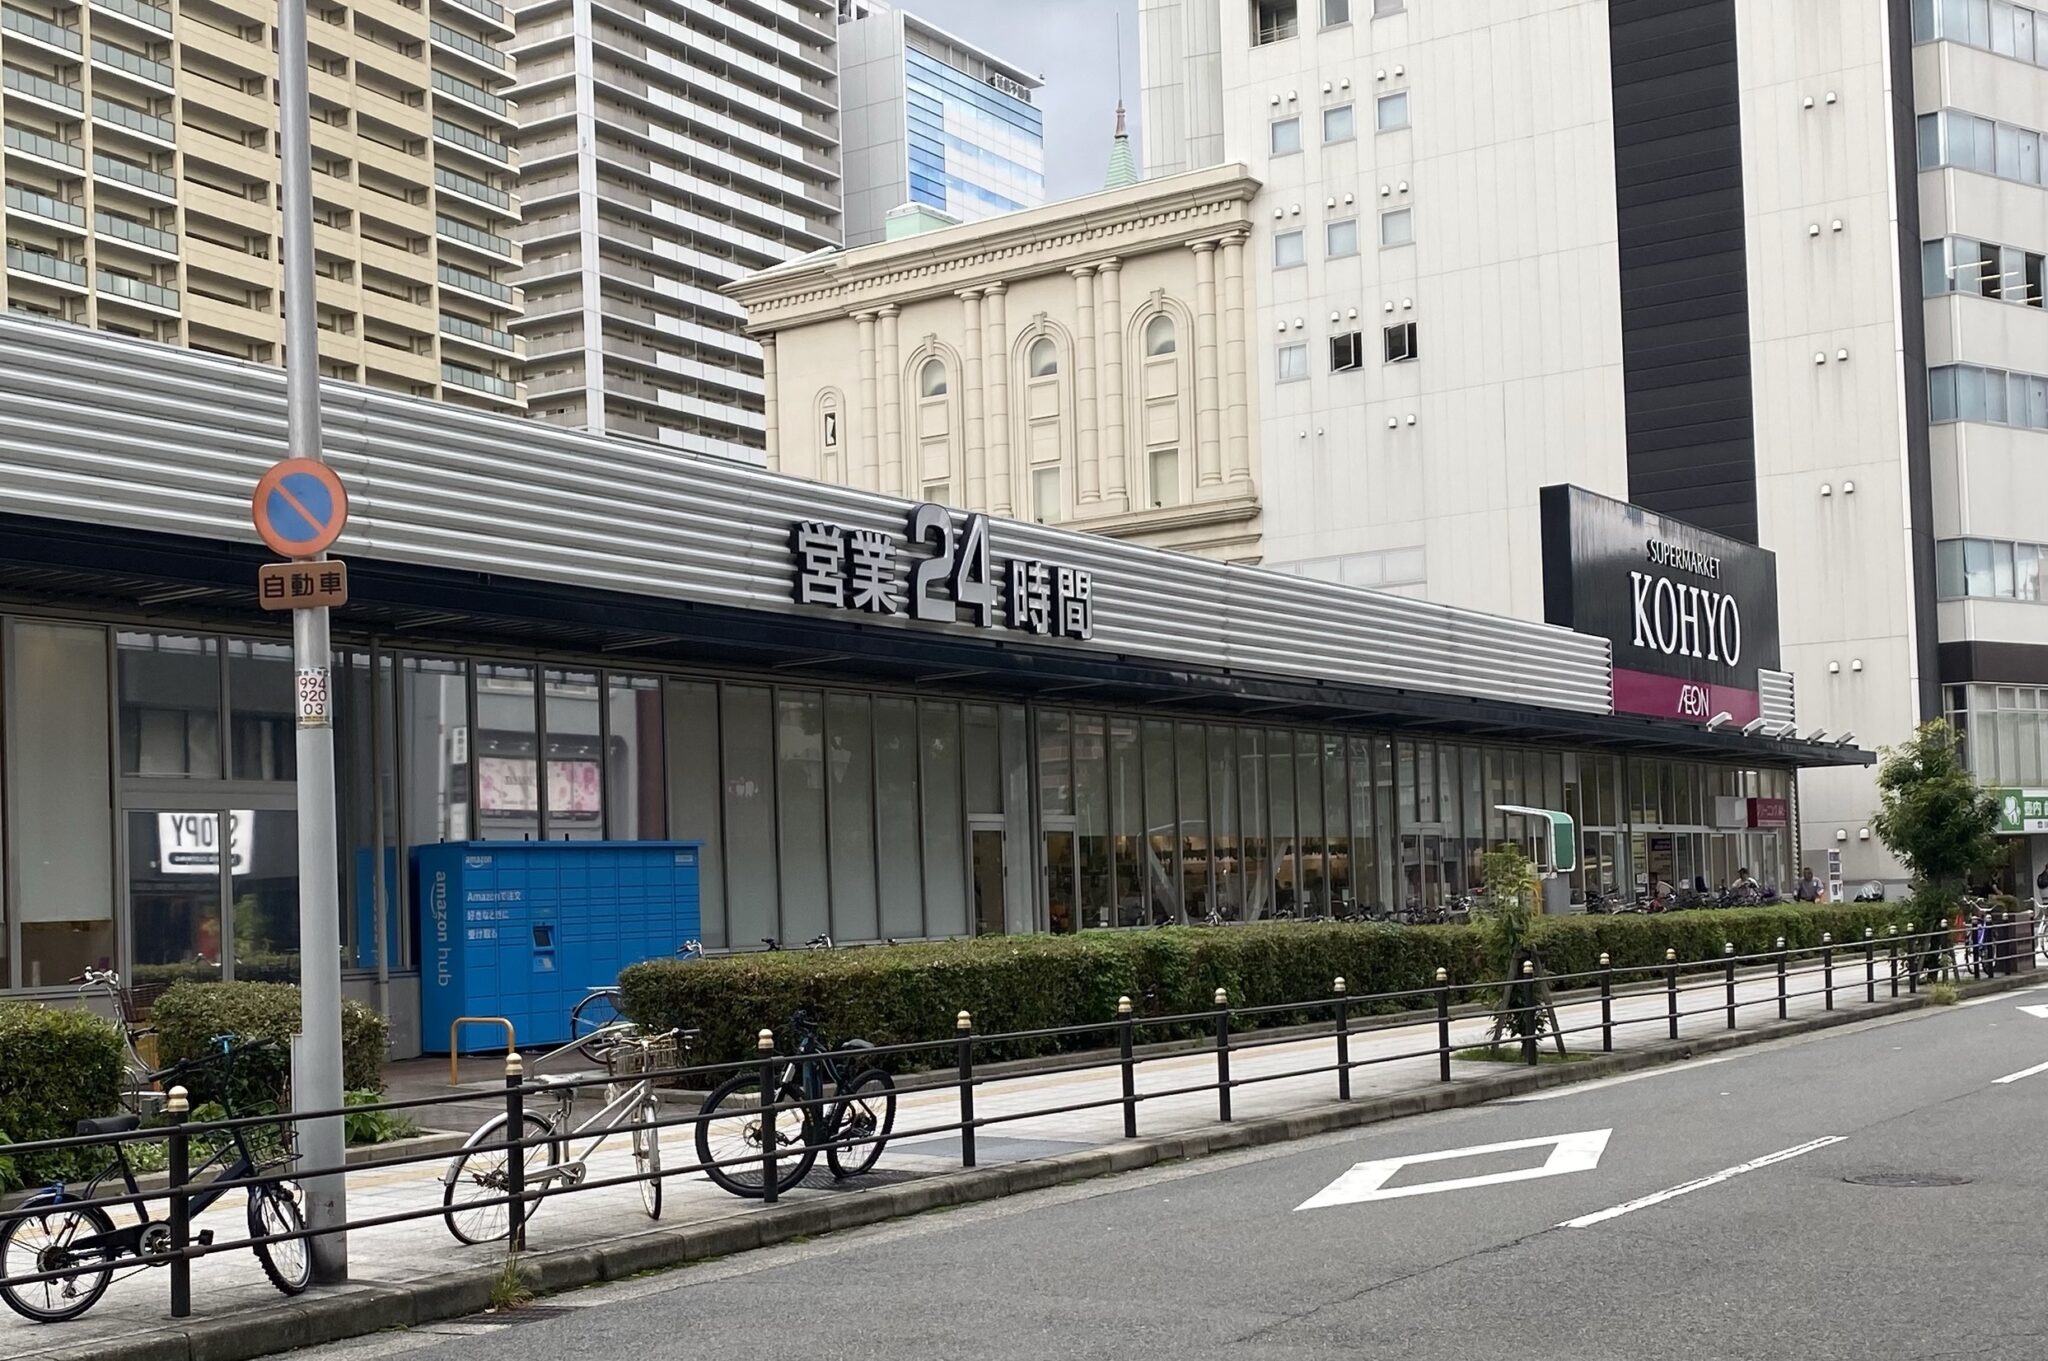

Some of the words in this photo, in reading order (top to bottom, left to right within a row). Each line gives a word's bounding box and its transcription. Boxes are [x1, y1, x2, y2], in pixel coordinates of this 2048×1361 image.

[794, 503, 1093, 640] 営業24時間
[1649, 539, 1721, 580] SUPERMARKET
[263, 570, 342, 598] 自動車
[1629, 571, 1742, 667] KOHYO
[299, 677, 327, 690] 994
[300, 690, 327, 702] 920
[304, 703, 324, 715] 03
[465, 855, 493, 866] amazon
[435, 871, 448, 942] amazon
[437, 947, 453, 987] hub
